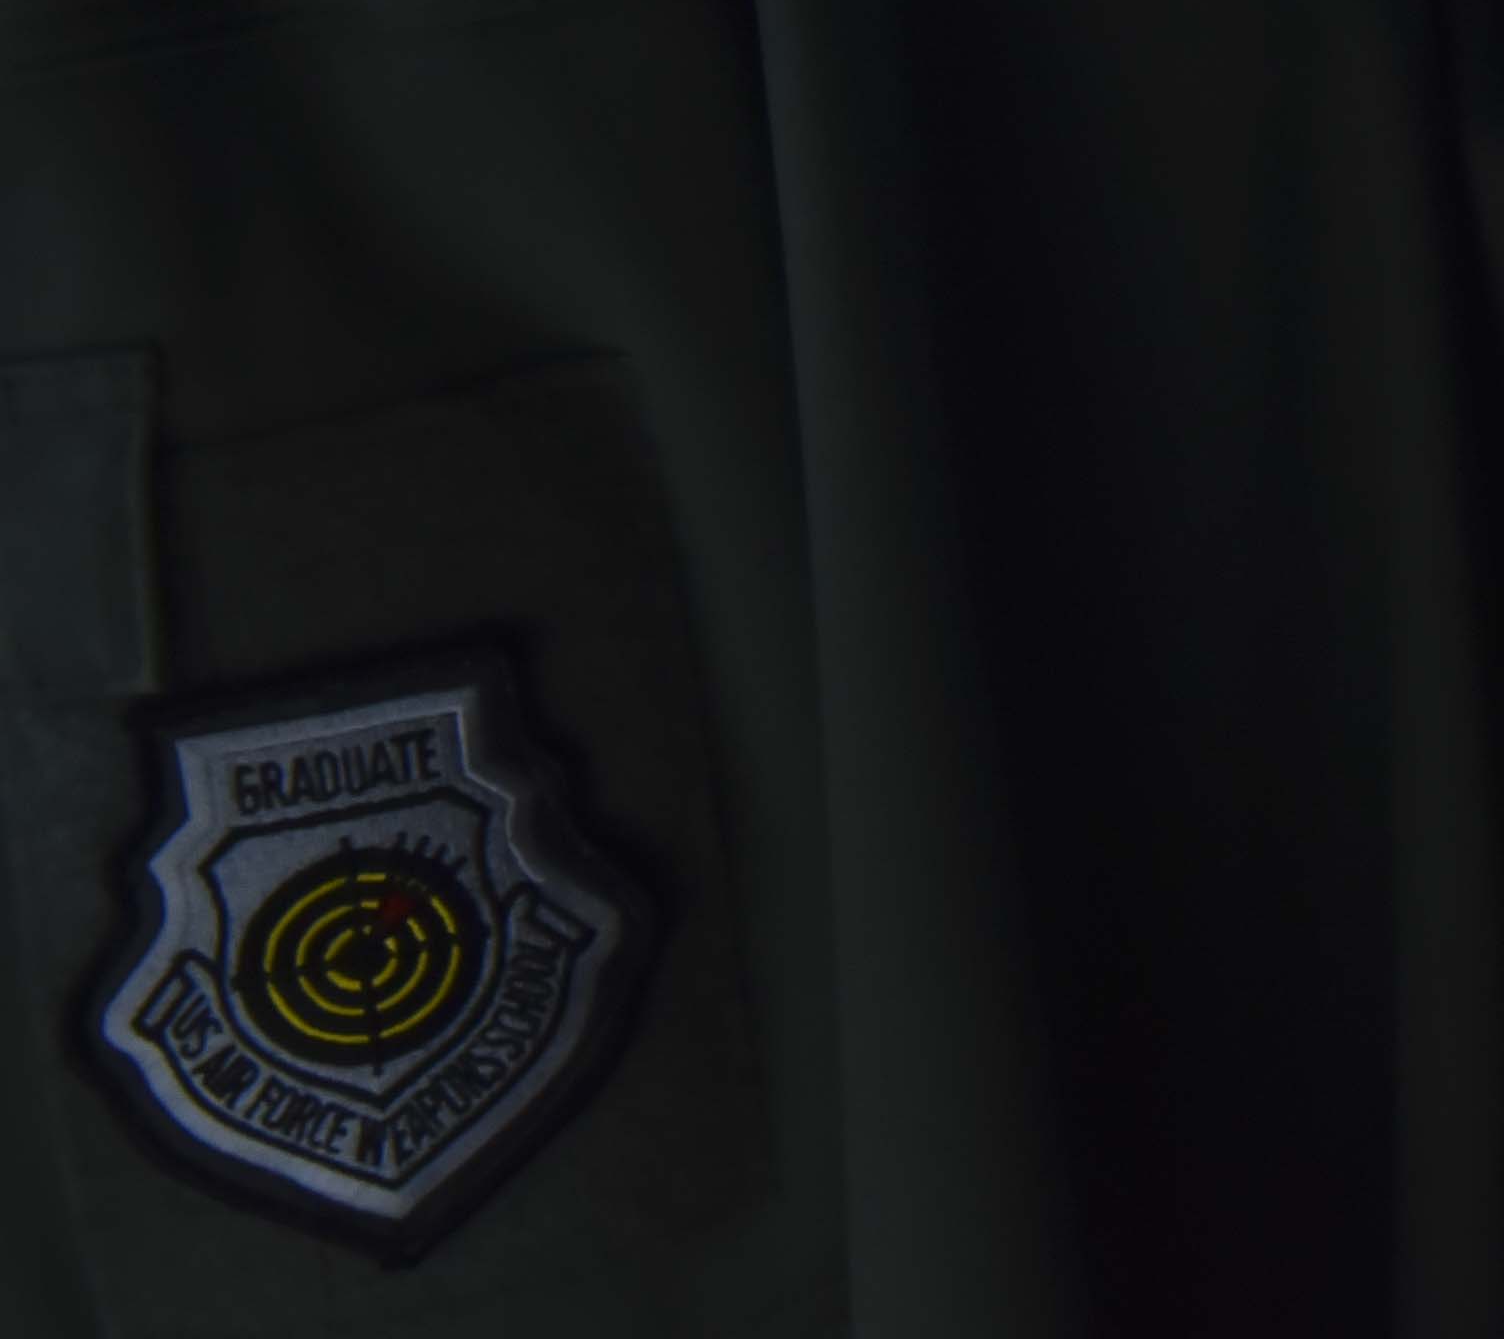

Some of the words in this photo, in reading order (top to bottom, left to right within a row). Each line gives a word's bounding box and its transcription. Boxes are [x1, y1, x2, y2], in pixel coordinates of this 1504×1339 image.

[235, 728, 442, 814] GRADUATE
[172, 989, 218, 1056] US
[195, 1047, 254, 1111] AIR
[249, 1079, 349, 1155] FORCE
[356, 1041, 504, 1166] WEAPONS
